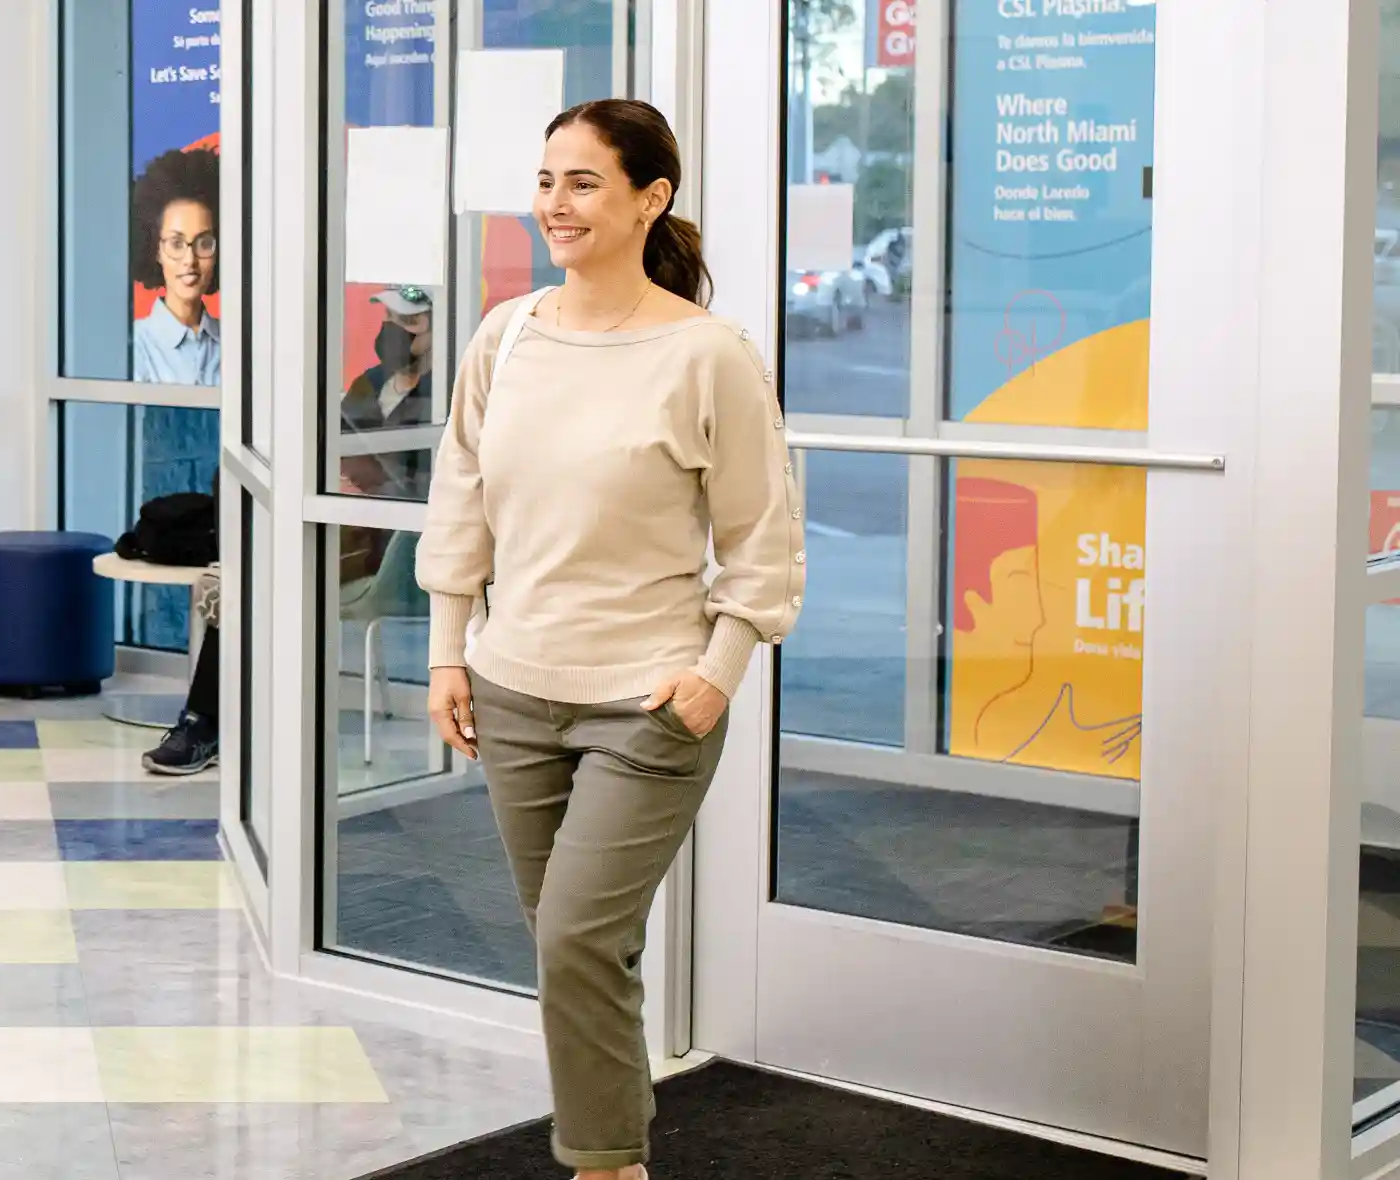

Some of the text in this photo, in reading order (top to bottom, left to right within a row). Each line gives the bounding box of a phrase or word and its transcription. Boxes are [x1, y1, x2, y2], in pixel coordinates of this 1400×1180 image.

[365, 0, 401, 17] Good
[998, 0, 1037, 18] CSL
[1015, 34, 1059, 49] damos
[1008, 55, 1032, 70] CSL
[180, 65, 208, 81] Save
[996, 93, 1068, 116] Where
[996, 118, 1137, 144] North Miami
[996, 146, 1117, 172] Does Good
[1077, 532, 1143, 570] Sha
[1076, 577, 1145, 632] Lif
